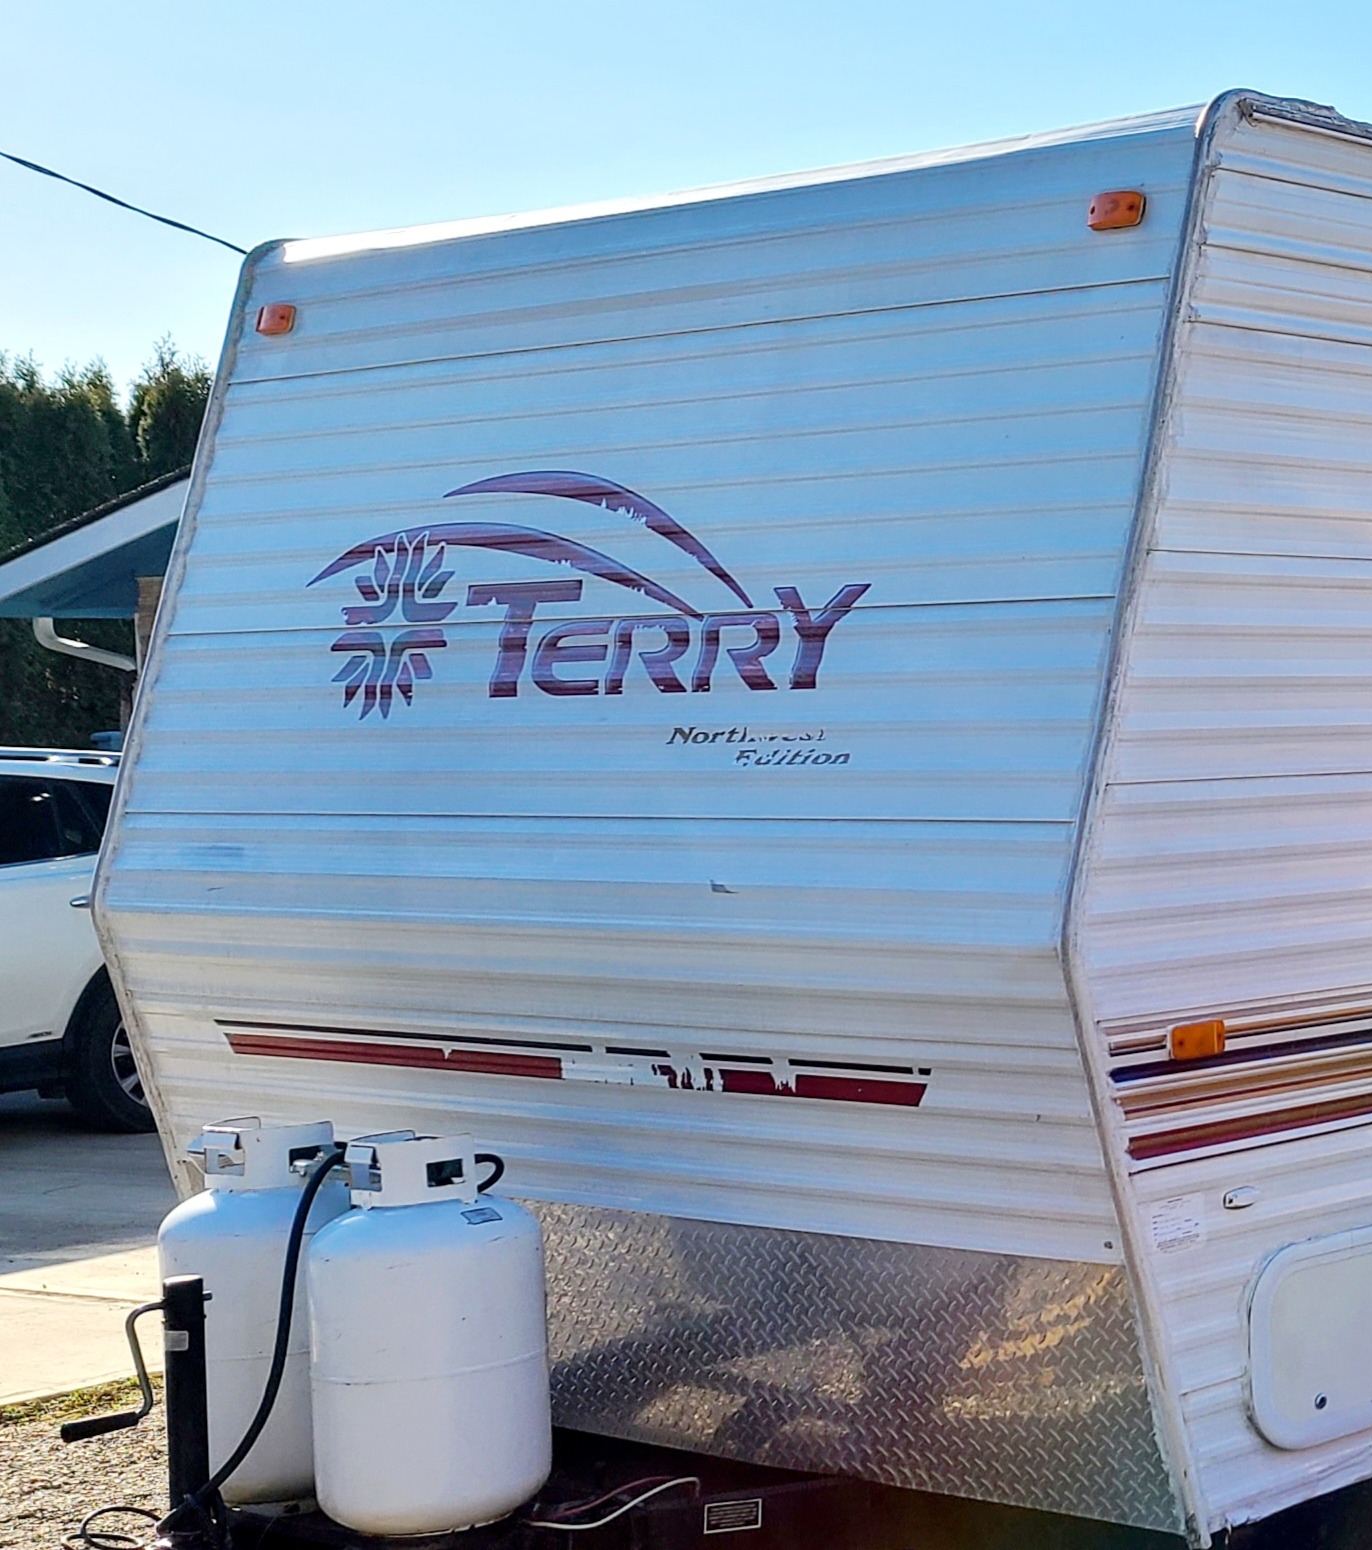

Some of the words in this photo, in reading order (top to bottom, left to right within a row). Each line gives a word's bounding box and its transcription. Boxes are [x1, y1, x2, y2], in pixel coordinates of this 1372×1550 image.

[465, 579, 872, 698] TERRY
[665, 726, 826, 745] Northst
[735, 748, 851, 767] Edition
